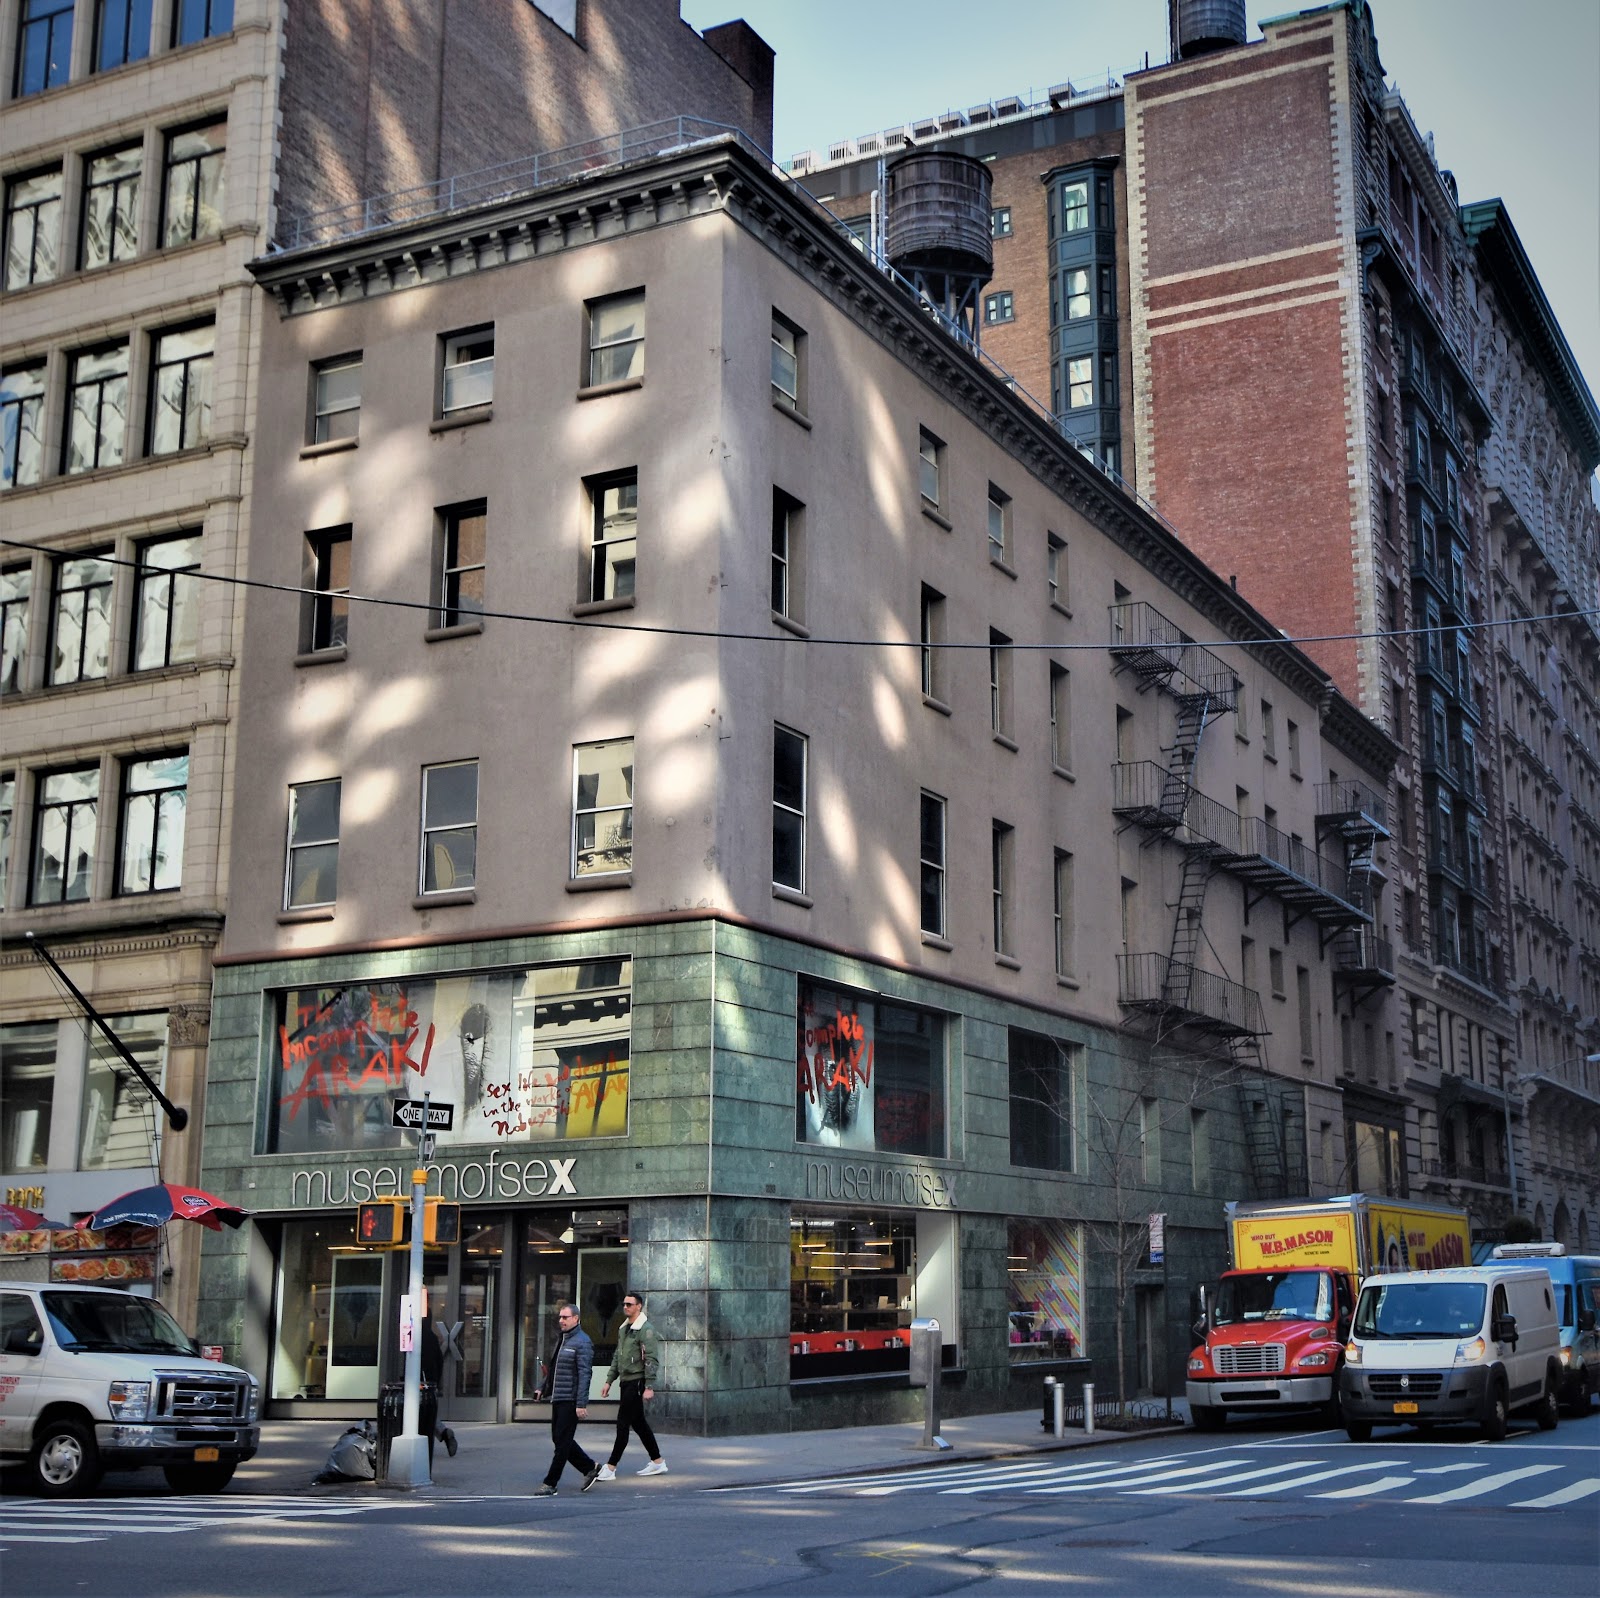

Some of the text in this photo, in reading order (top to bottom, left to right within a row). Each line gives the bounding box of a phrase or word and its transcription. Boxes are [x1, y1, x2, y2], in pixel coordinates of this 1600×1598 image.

[279, 1022, 435, 1121] ARAKI
[402, 1108, 446, 1122] ONE WAY
[482, 1106, 499, 1118] in
[501, 1097, 521, 1113] the
